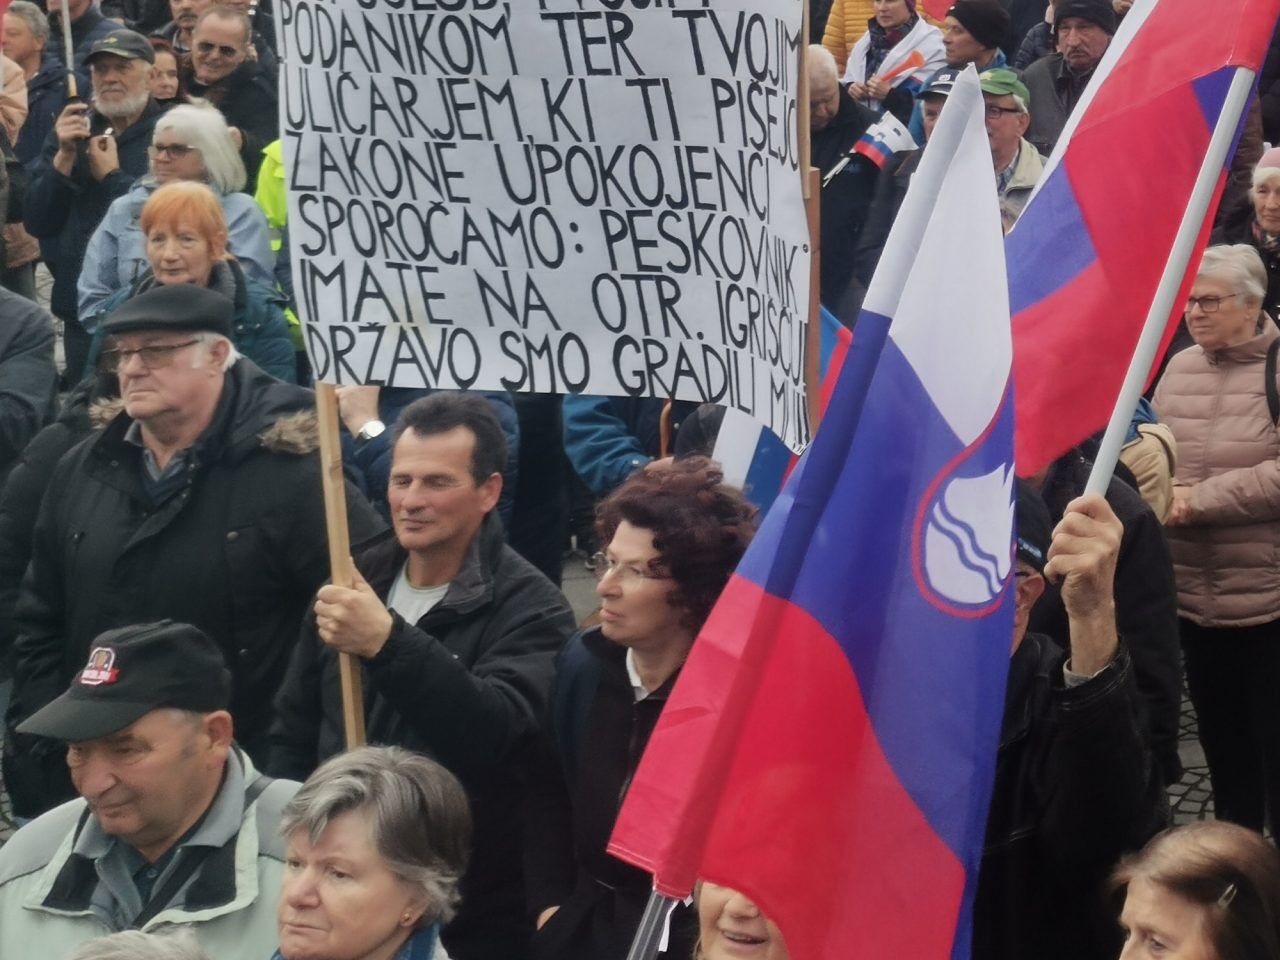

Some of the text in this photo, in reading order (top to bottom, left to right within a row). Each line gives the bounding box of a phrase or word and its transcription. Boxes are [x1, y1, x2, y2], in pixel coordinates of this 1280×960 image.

[540, 10, 645, 77] TER
[672, 9, 801, 93] TVOJIM
[542, 77, 593, 143] KI
[625, 77, 681, 143] TI
[286, 130, 770, 226] ZAKONE UPOKOJENCI
[300, 193, 798, 315] SPOROČAMO: PESKOVNIK
[302, 258, 454, 326] IMATE
[476, 269, 562, 331] NA
[591, 272, 705, 341] OTR.
[307, 322, 482, 390] DRŽAVO
[500, 329, 591, 394] SMO
[613, 335, 756, 418] GRADILI
